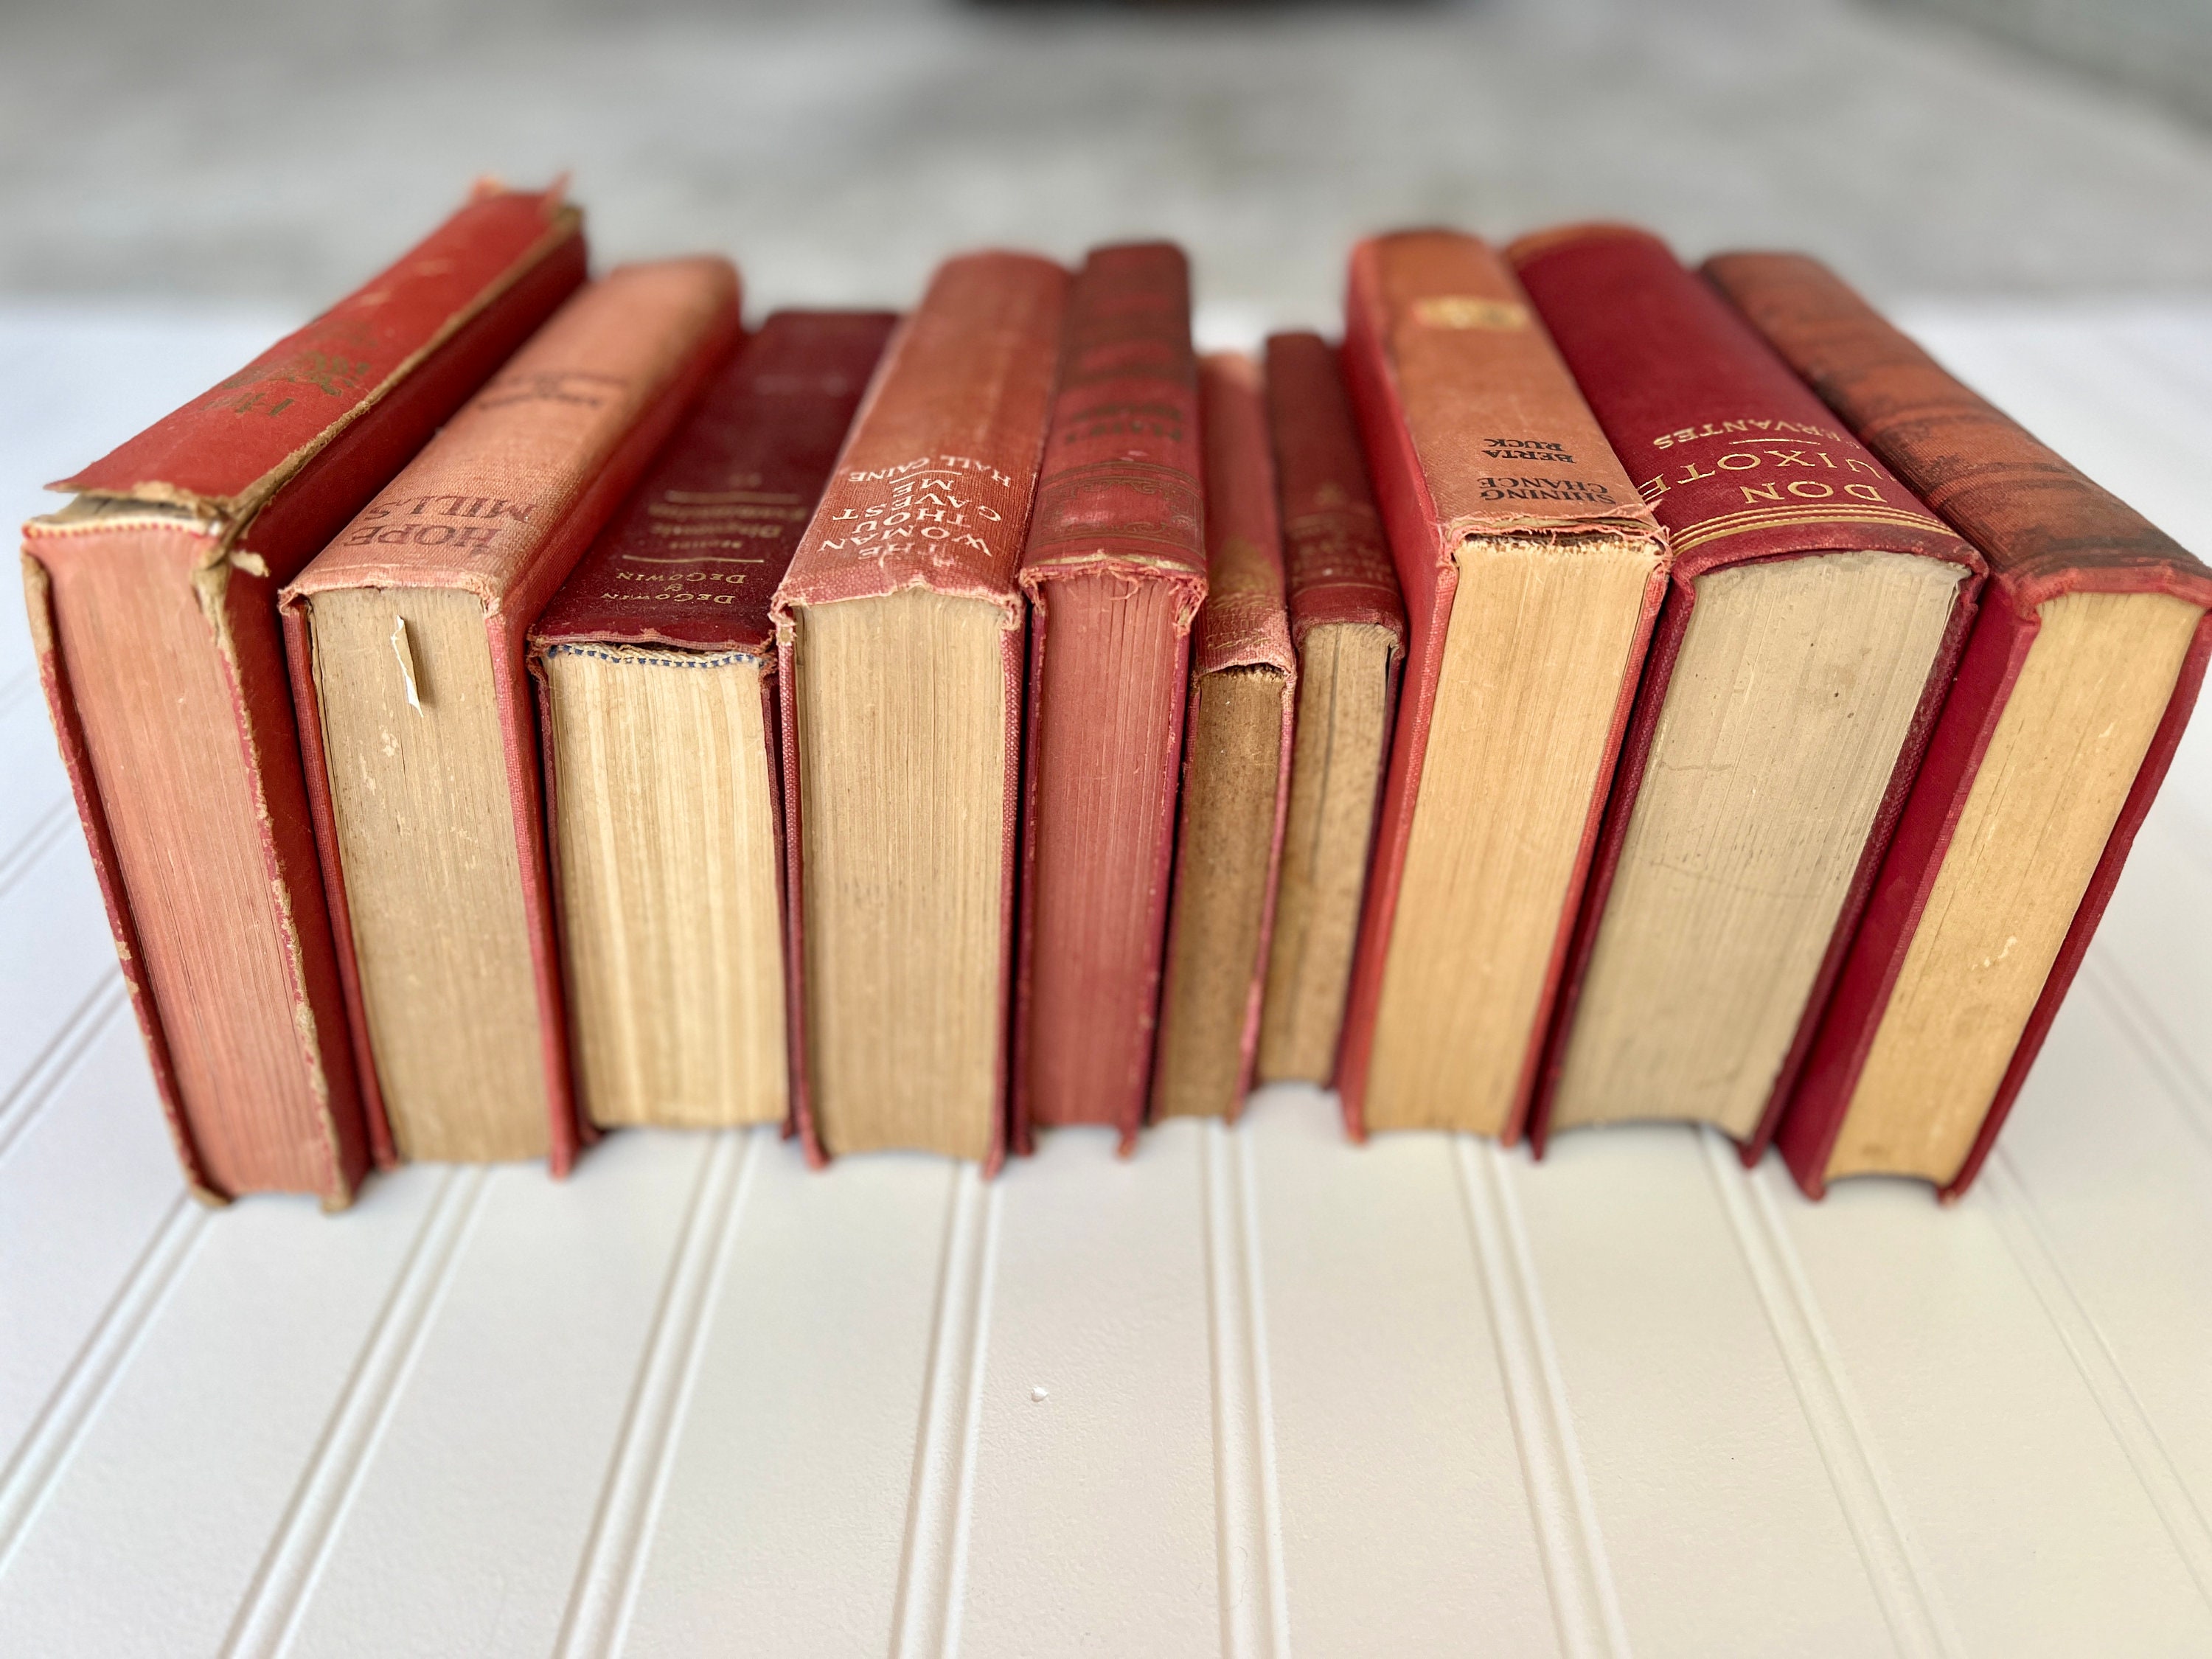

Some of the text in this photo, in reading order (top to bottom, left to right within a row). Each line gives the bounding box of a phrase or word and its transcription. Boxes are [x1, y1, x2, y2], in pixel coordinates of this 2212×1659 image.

[1481, 450, 1576, 464] BERTA
[1484, 439, 1565, 452] RUCK
[848, 454, 1011, 487] HALL CAINE
[1638, 449, 1898, 502] UIXOTE
[892, 479, 955, 498] ME
[1478, 477, 1609, 494] CHANCE
[1480, 489, 1617, 505] SHINING
[1739, 481, 1888, 504] DON
[364, 495, 538, 524] MILLS
[832, 493, 1001, 522] GAVEST
[852, 508, 971, 535] THOU
[344, 524, 501, 549] HOPE
[816, 524, 992, 557] WOMAN
[664, 582, 683, 592] &
